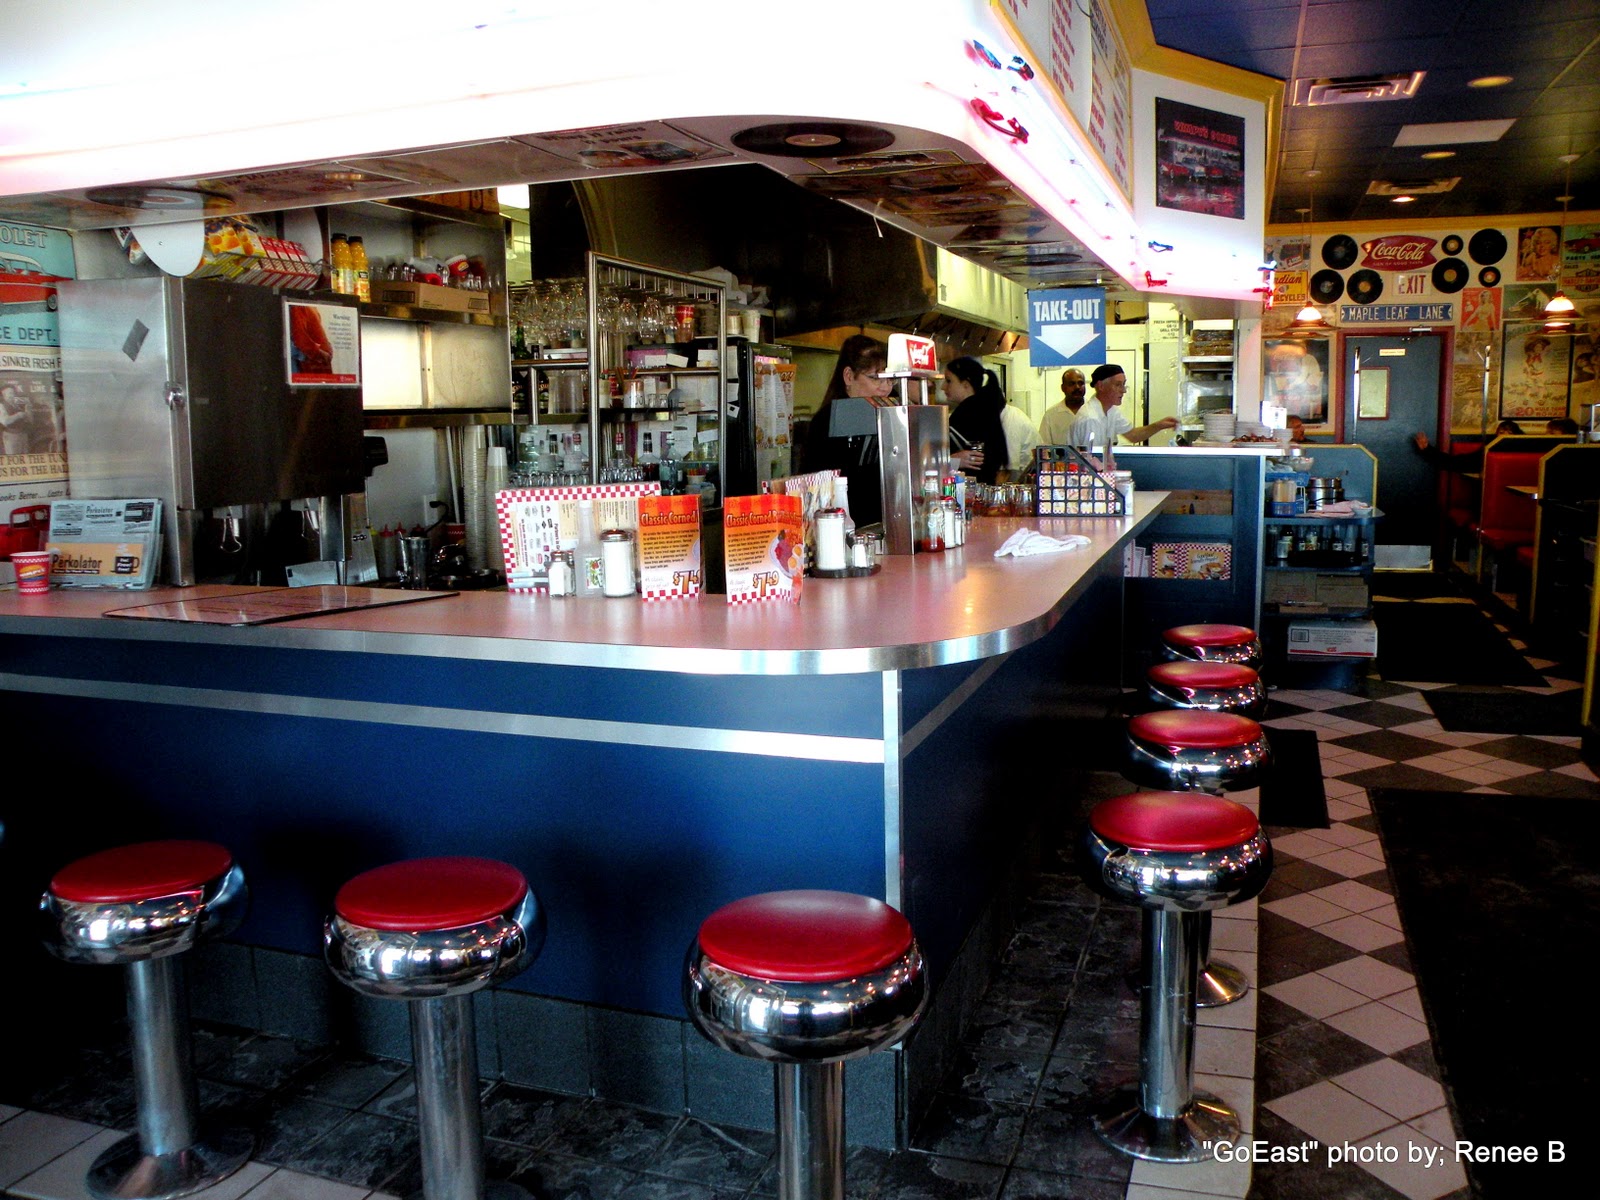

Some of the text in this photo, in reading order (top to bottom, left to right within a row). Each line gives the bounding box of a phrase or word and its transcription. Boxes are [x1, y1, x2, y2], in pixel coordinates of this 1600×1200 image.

[1371, 242, 1428, 260] Coca-Cola
[1274, 273, 1302, 284] ndian
[1398, 274, 1426, 295] EXIT
[1033, 299, 1101, 322] TAKE-OUT
[1348, 305, 1444, 320] MAPLE LEAF LANE
[17, 327, 56, 341] DEPT.
[2, 355, 31, 368] SINKER
[32, 357, 56, 369] FRESH
[7, 455, 26, 465] FOR
[28, 454, 45, 464] THE
[10, 466, 29, 476] FOR
[31, 465, 48, 475] THE
[641, 513, 668, 526] Classic
[668, 511, 696, 525] Corned
[726, 513, 749, 528] Classic
[749, 511, 772, 526] Corned
